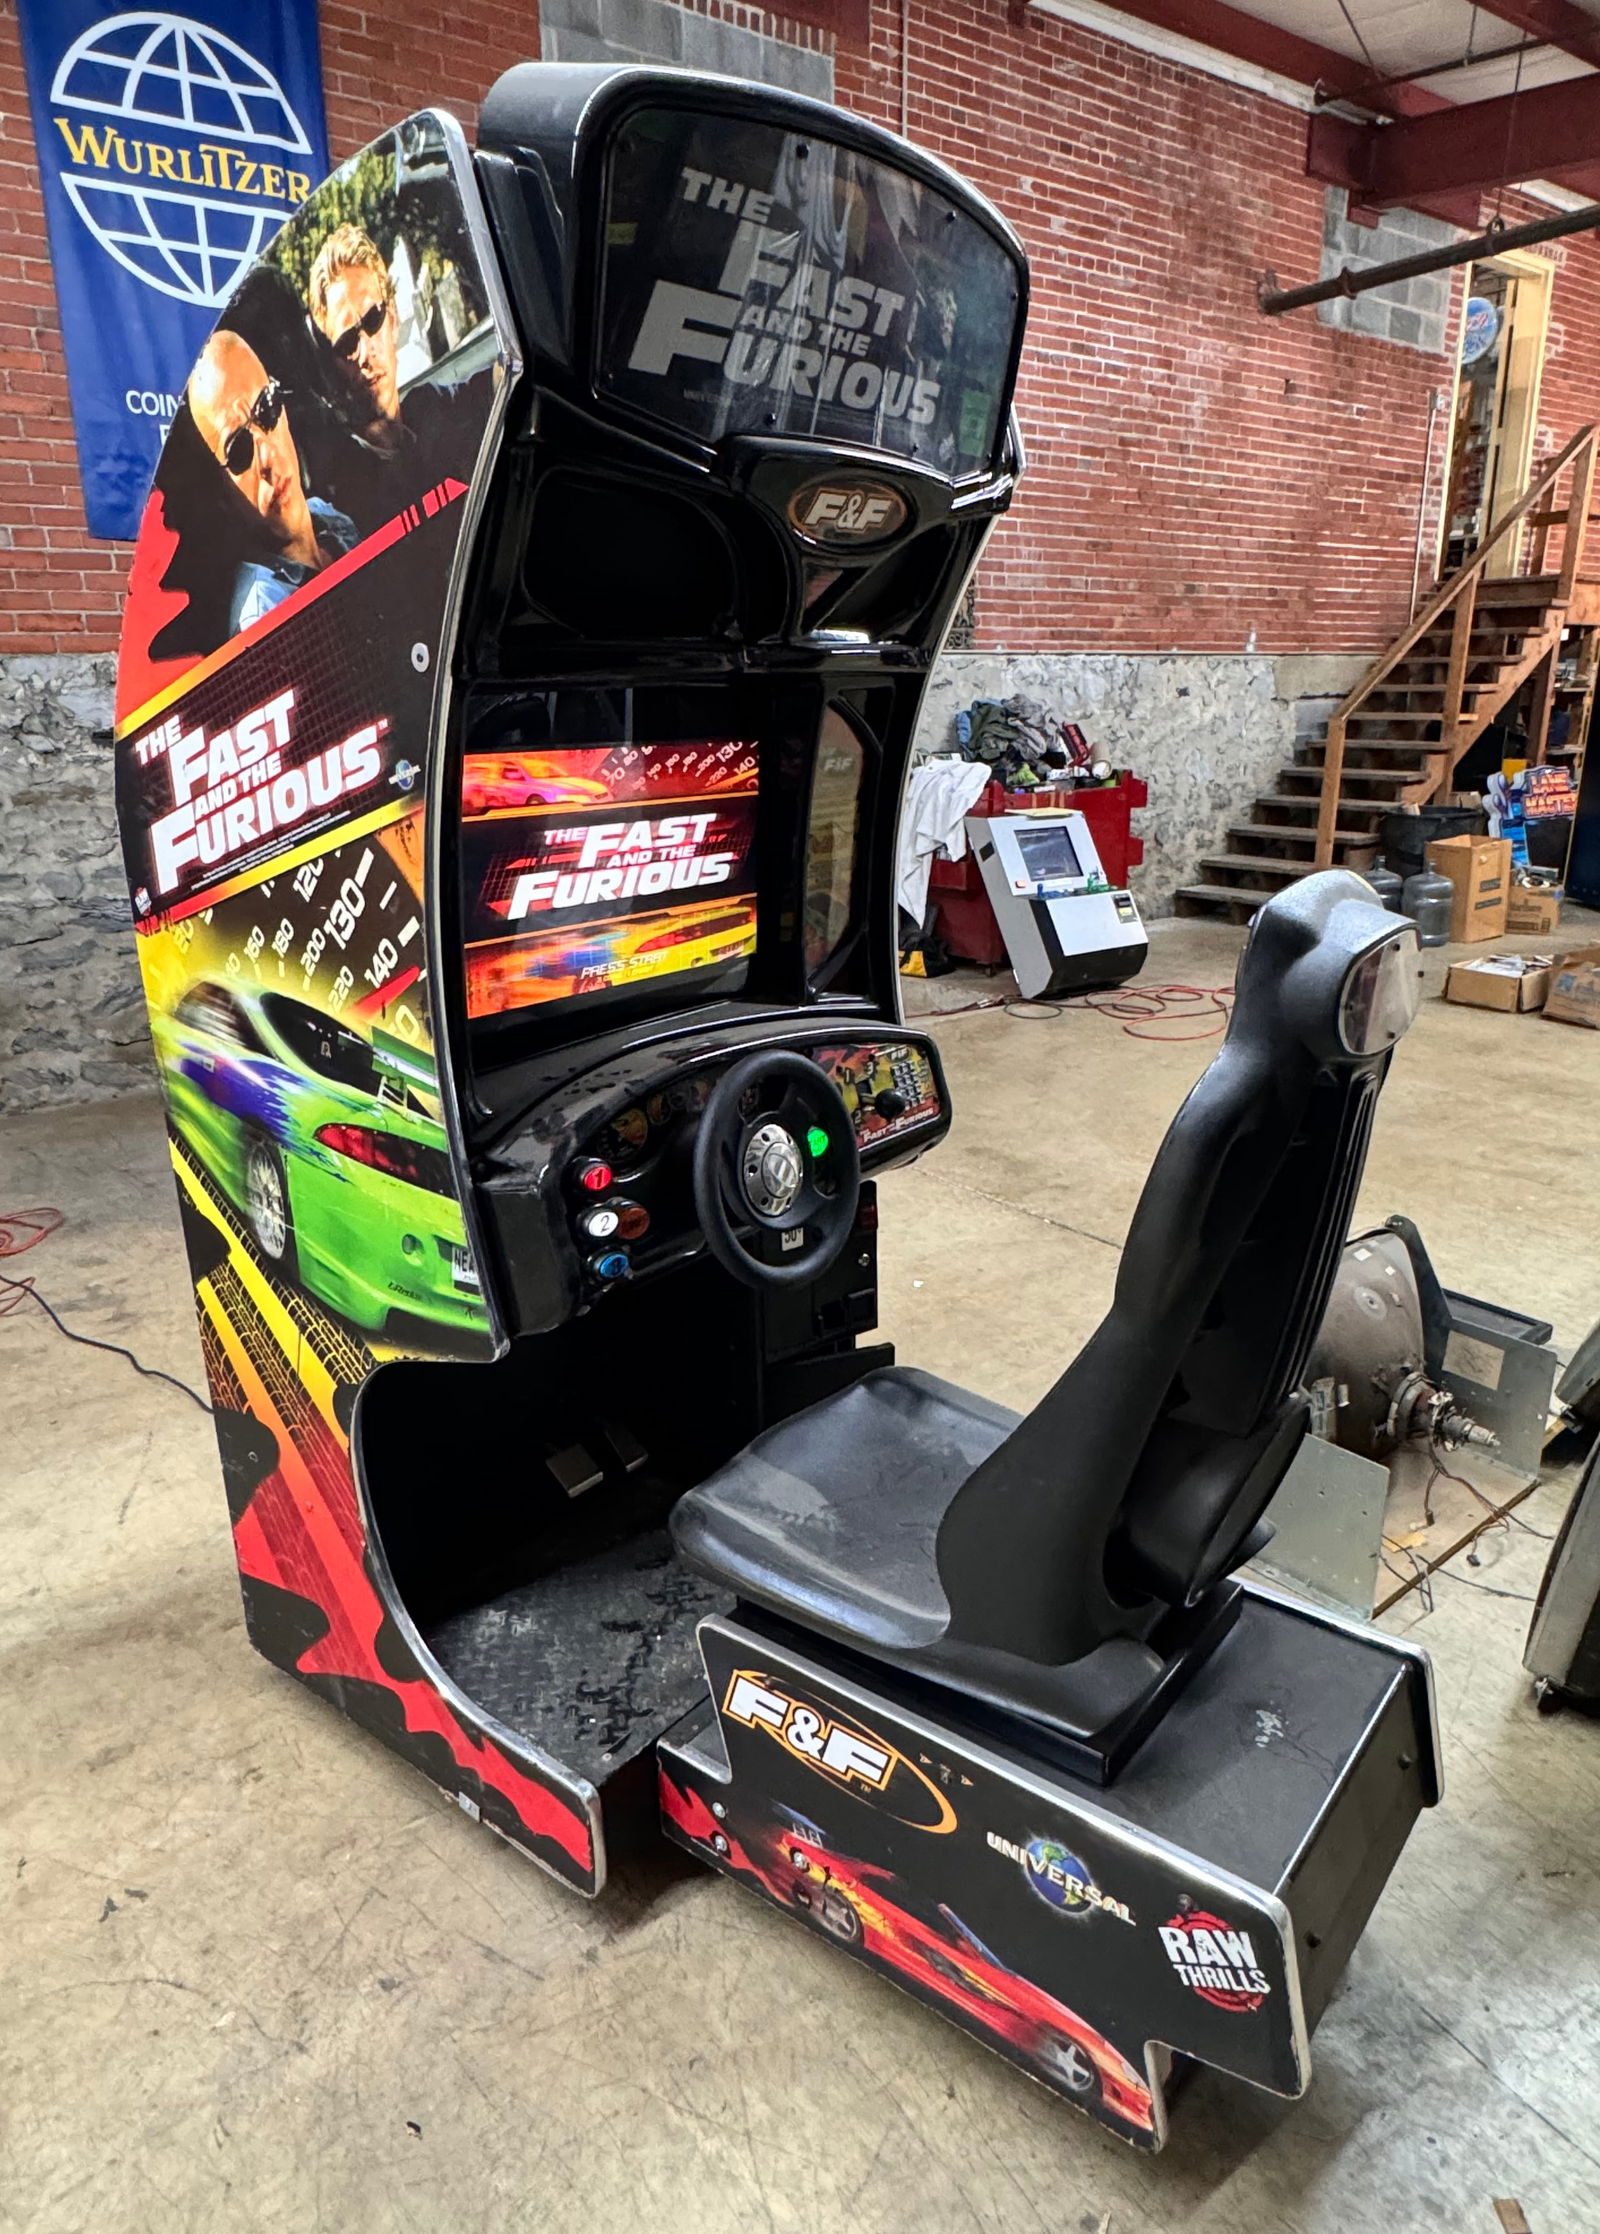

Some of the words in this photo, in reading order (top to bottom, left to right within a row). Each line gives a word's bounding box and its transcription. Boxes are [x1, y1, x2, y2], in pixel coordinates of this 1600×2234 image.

[54, 118, 310, 204] WURLITZER
[679, 166, 774, 224] THE
[717, 217, 906, 338] FAST
[628, 280, 942, 426] FURIOUS
[739, 303, 813, 341] AND
[816, 325, 872, 357] THE
[804, 491, 892, 532] F&F
[135, 715, 182, 765] THE
[168, 689, 295, 808] FAST
[151, 726, 381, 895] FURIOUS
[195, 780, 238, 820] AND
[238, 750, 282, 790] THE
[544, 827, 589, 846] THE
[578, 813, 717, 869] FAST
[607, 849, 652, 868] AND
[659, 844, 696, 860] THE
[507, 852, 733, 920] FURIOUS
[271, 918, 294, 958] 180
[324, 878, 365, 950] 130
[244, 925, 265, 964] 160
[300, 927, 326, 976] 200
[364, 938, 398, 988] 140
[581, 959, 627, 980] PRESS
[328, 966, 354, 1013] 220
[592, 1169, 603, 1188] 1
[600, 1214, 610, 1233] 2
[725, 1672, 894, 1786] F&F
[986, 1831, 1137, 1927] UNIVERSAL
[1158, 1926, 1258, 1969] RAW
[1172, 1963, 1272, 1995] THRILLS
